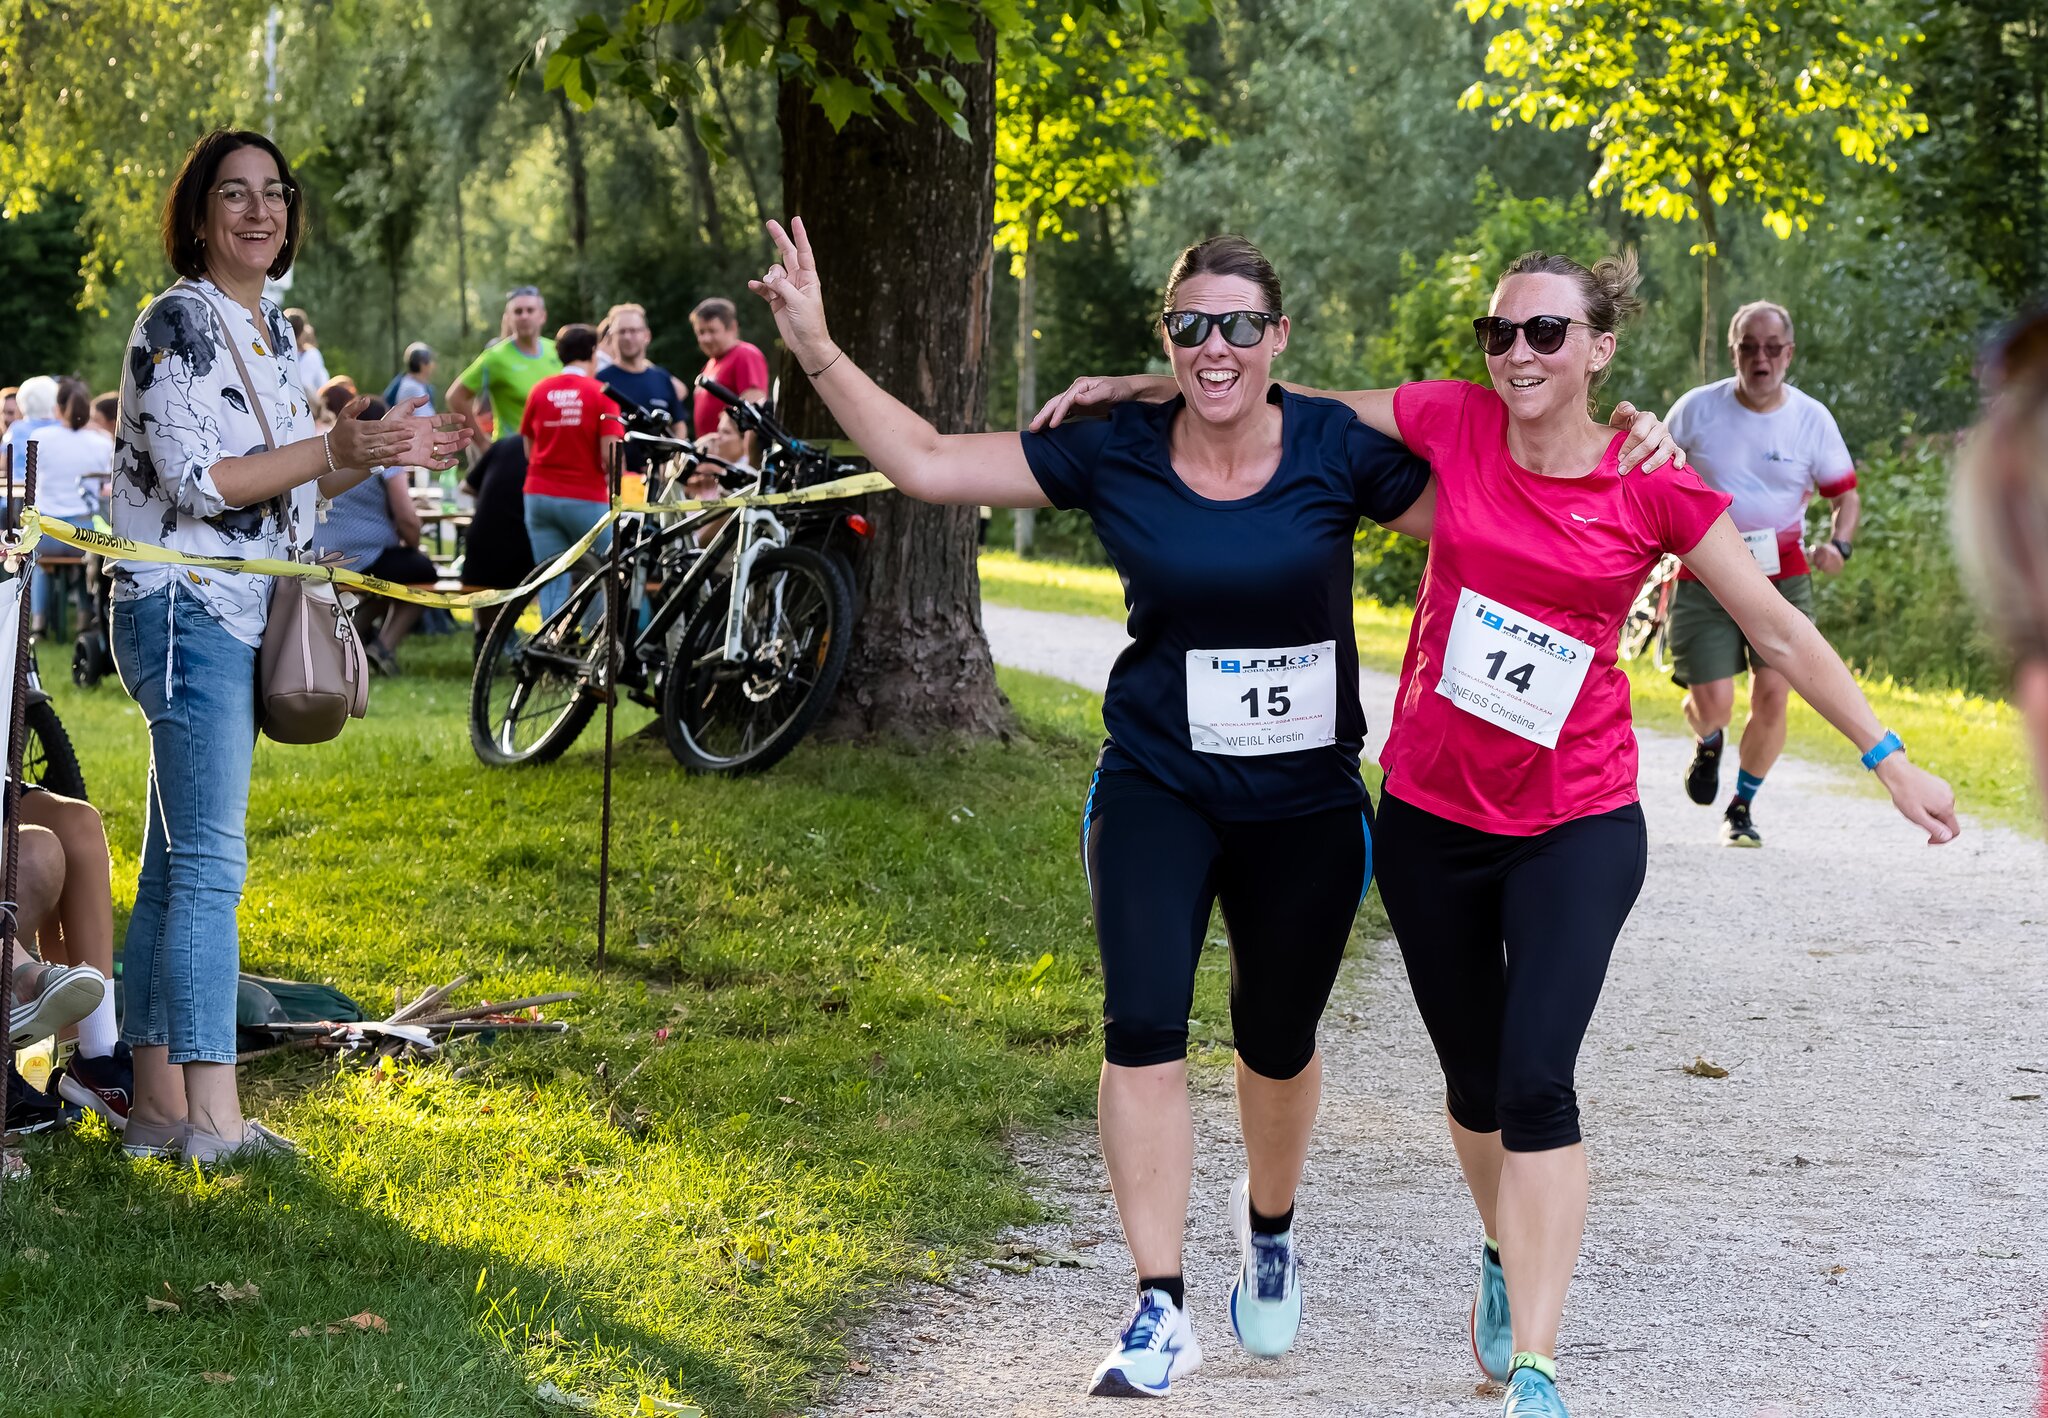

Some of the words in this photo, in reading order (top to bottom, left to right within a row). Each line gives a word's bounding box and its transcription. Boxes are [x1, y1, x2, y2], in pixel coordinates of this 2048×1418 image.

[1523, 640, 1537, 649] MIT
[1539, 648, 1573, 664] ZUKUNFT
[1282, 662, 1318, 671] ZUKUNFT
[1485, 650, 1536, 694] 14
[1240, 685, 1291, 718] 15
[1506, 692, 1522, 702] 2024
[1522, 699, 1553, 716] TIMELKAM
[1291, 714, 1323, 722] TIMELKAM
[1490, 702, 1536, 730] Christina
[1226, 735, 1264, 747] WEIßL
[1268, 731, 1304, 745] Kerstin
